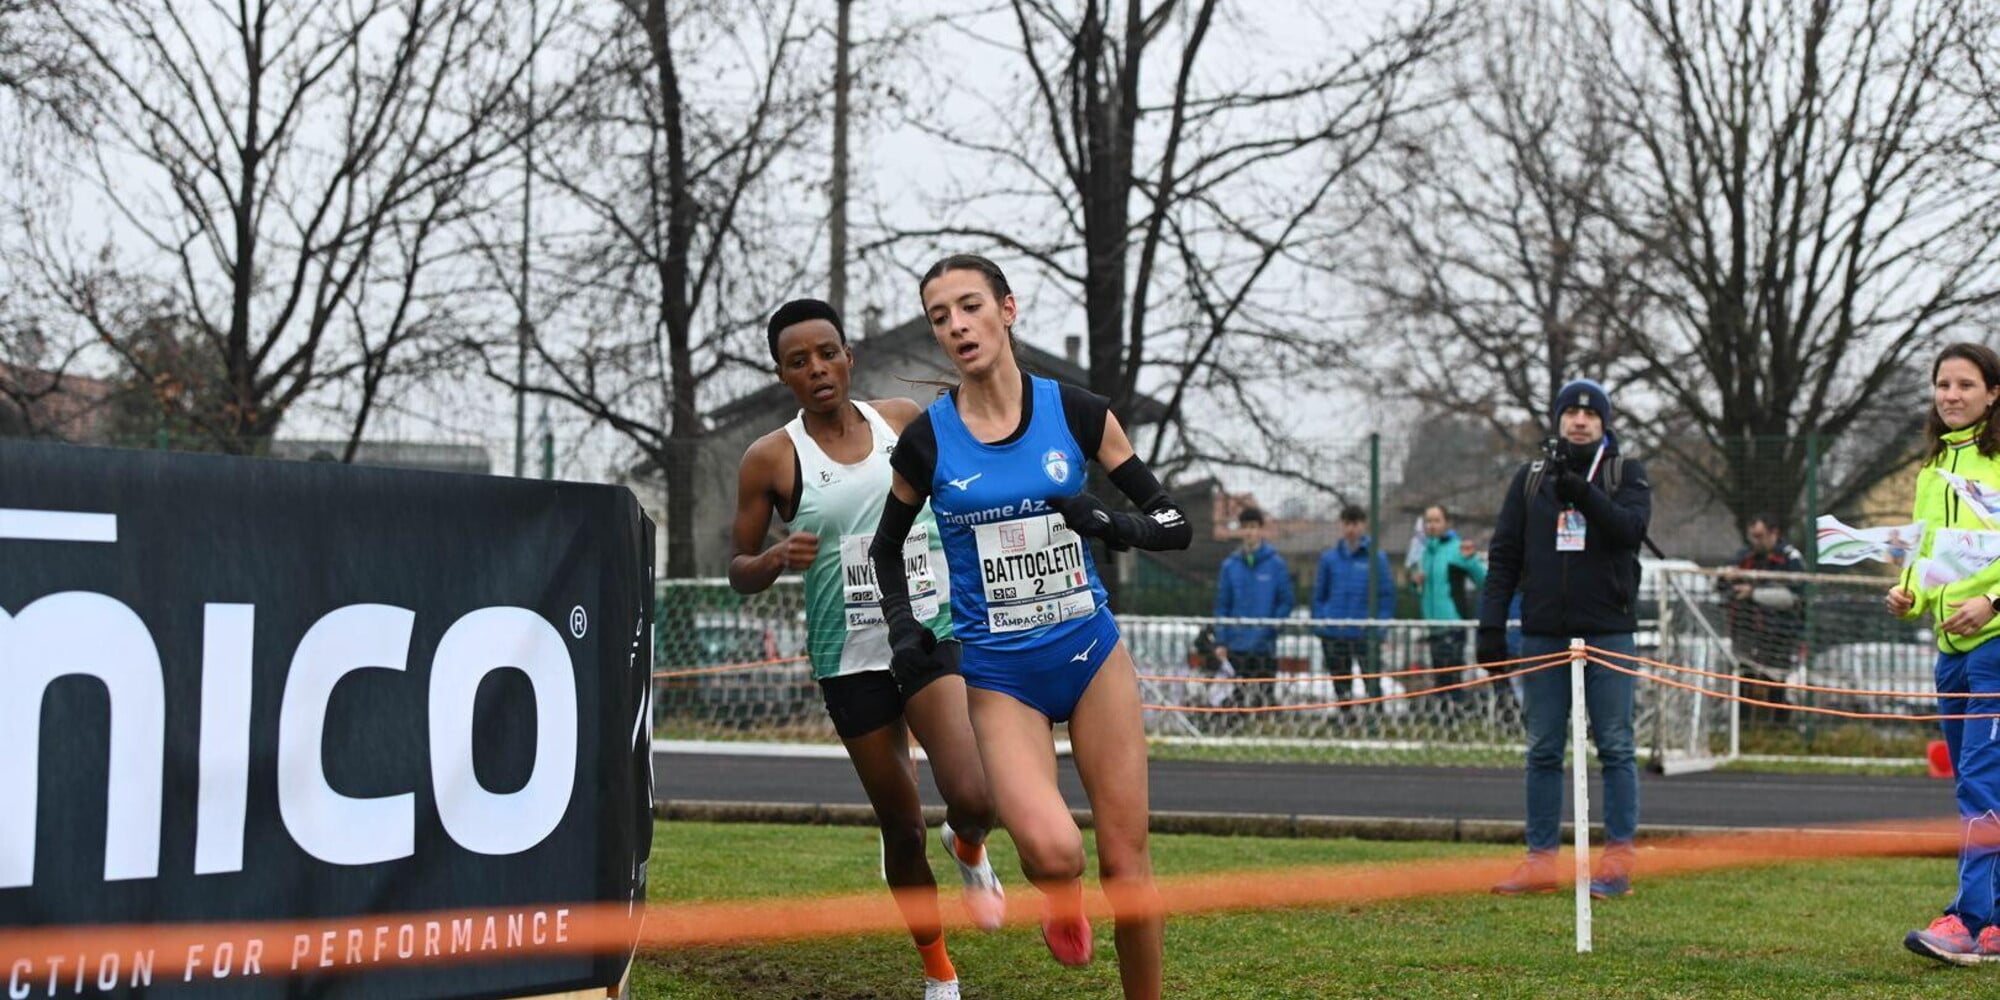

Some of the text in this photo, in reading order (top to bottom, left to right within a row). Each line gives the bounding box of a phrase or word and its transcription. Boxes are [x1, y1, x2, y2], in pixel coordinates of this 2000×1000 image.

[983, 542, 1081, 584] BATTOCLETTI
[1033, 578, 1045, 595] 2
[994, 612, 1055, 627] CAMPACCIO
[184, 939, 264, 982] FOR
[291, 909, 569, 970] PERFORMANCE
